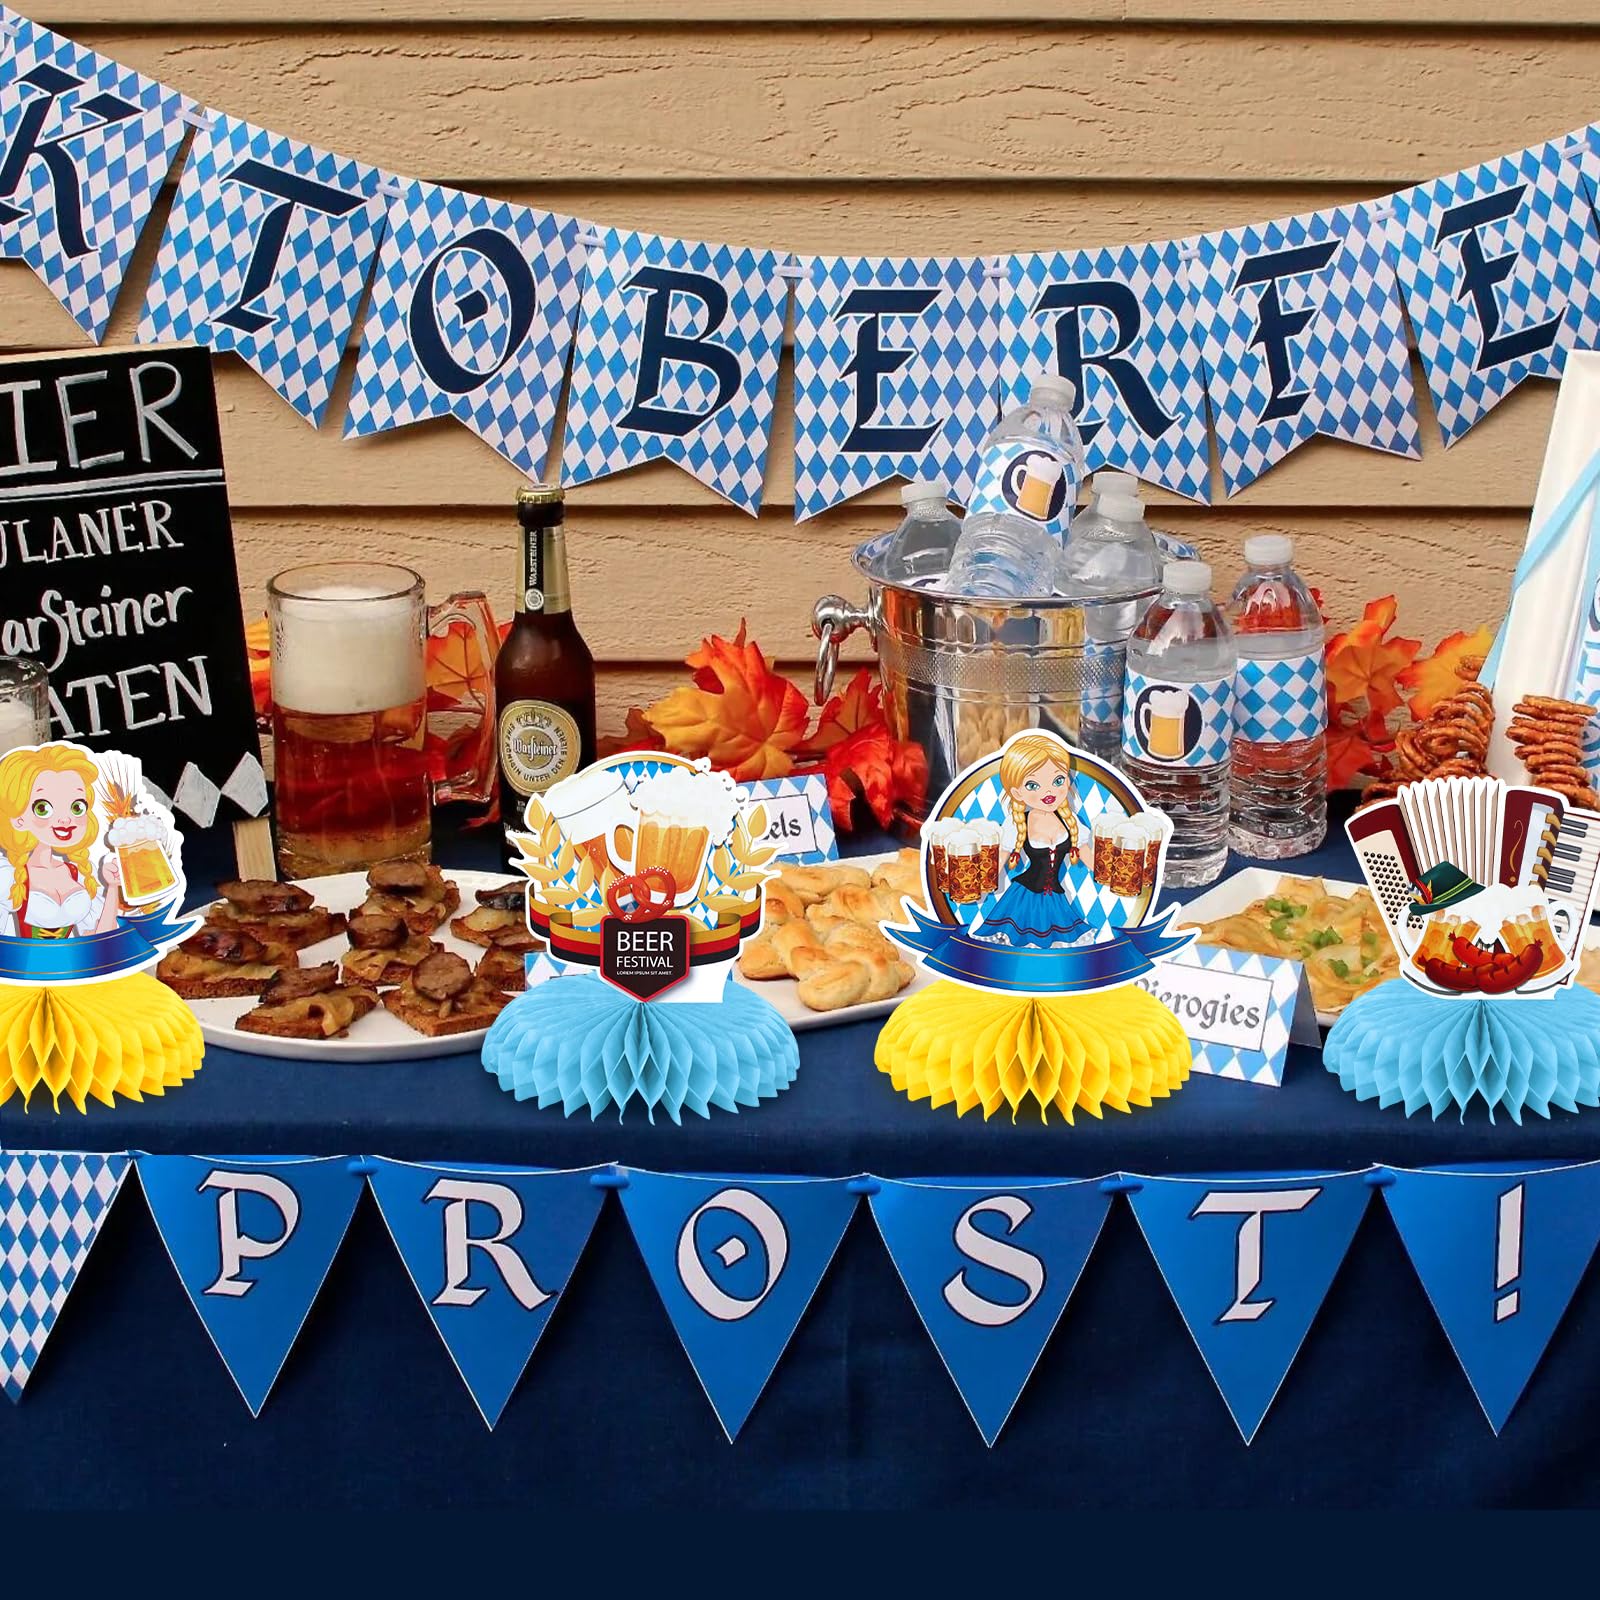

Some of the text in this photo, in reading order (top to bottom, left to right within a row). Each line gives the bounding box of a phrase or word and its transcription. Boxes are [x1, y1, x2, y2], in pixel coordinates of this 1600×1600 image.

[0, 361, 199, 476] IER
[47, 655, 213, 738] ATEN
[761, 810, 802, 841] els
[616, 956, 674, 968] FESTIVAL
[617, 931, 674, 952] BEER
[198, 1169, 1525, 1326] PROST!
